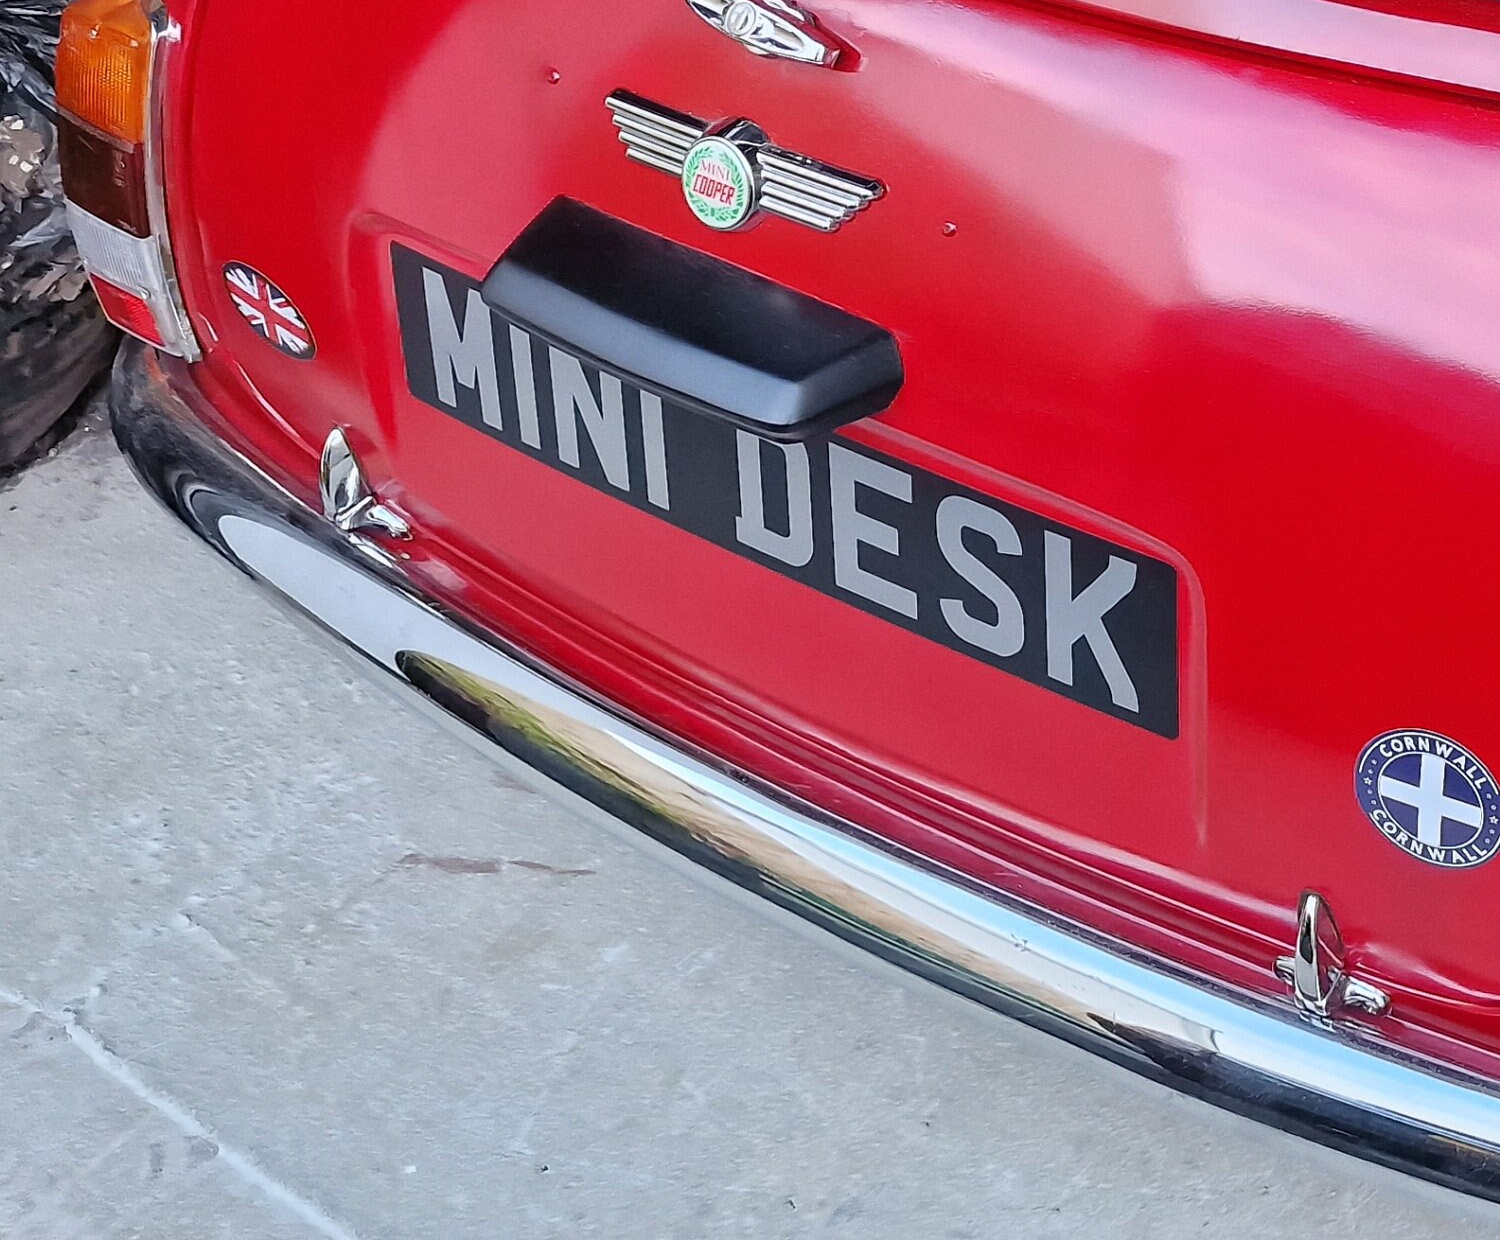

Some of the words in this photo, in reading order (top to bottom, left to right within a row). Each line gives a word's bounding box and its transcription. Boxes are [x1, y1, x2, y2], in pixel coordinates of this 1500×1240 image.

[692, 174, 736, 206] COOPER
[701, 159, 731, 181] MINI
[421, 266, 670, 512] MINI
[734, 427, 1140, 714] DESK
[1379, 736, 1487, 790] CORNWALL
[1372, 809, 1487, 864] CORNWALL
